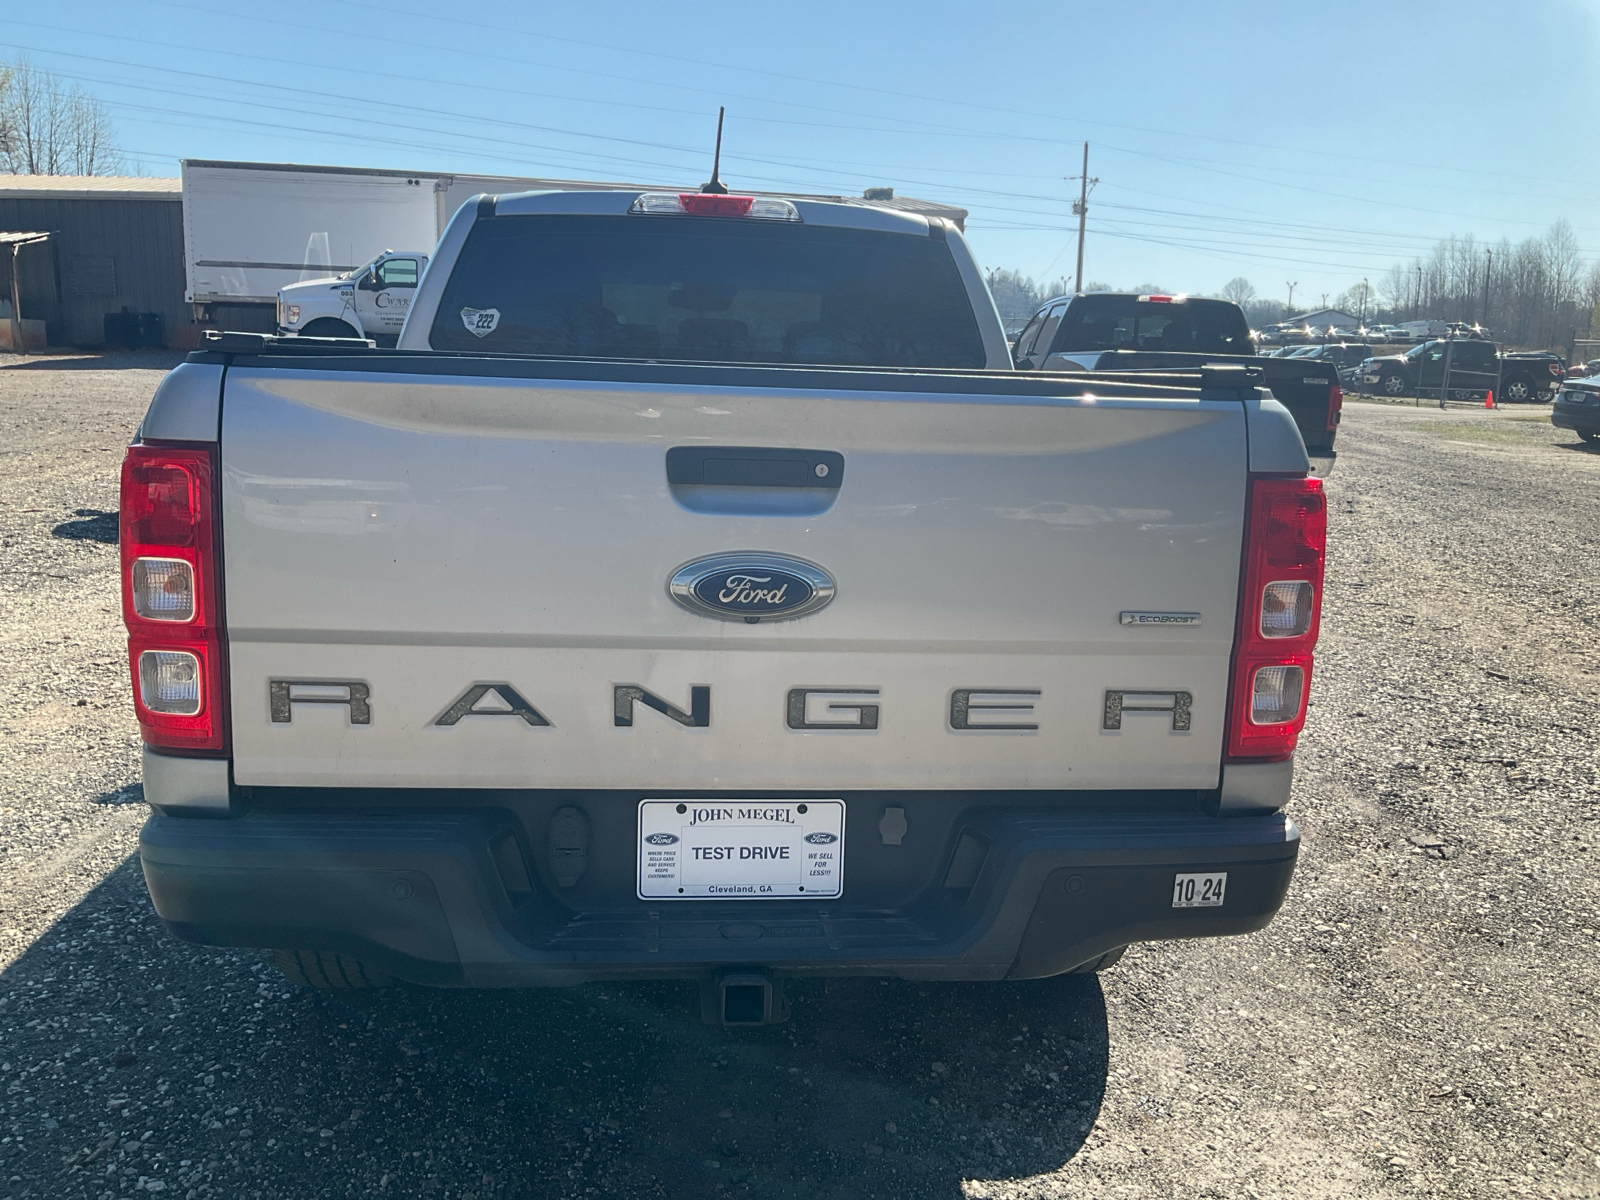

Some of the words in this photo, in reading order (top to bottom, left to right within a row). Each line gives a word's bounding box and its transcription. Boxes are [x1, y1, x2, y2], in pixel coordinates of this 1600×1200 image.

[476, 314, 495, 329] 222
[718, 574, 788, 604] Ford
[270, 678, 1193, 731] RANGER
[689, 808, 734, 826] JOHN
[738, 808, 795, 824] MEGEL
[651, 834, 673, 843] Ford
[810, 833, 832, 843] Ford
[692, 847, 734, 860] TEST
[739, 847, 790, 860] DRIVE
[708, 886, 756, 894] Cleveland,
[759, 885, 773, 893] GA
[1176, 879, 1195, 902] 10
[1201, 878, 1222, 901] 24
